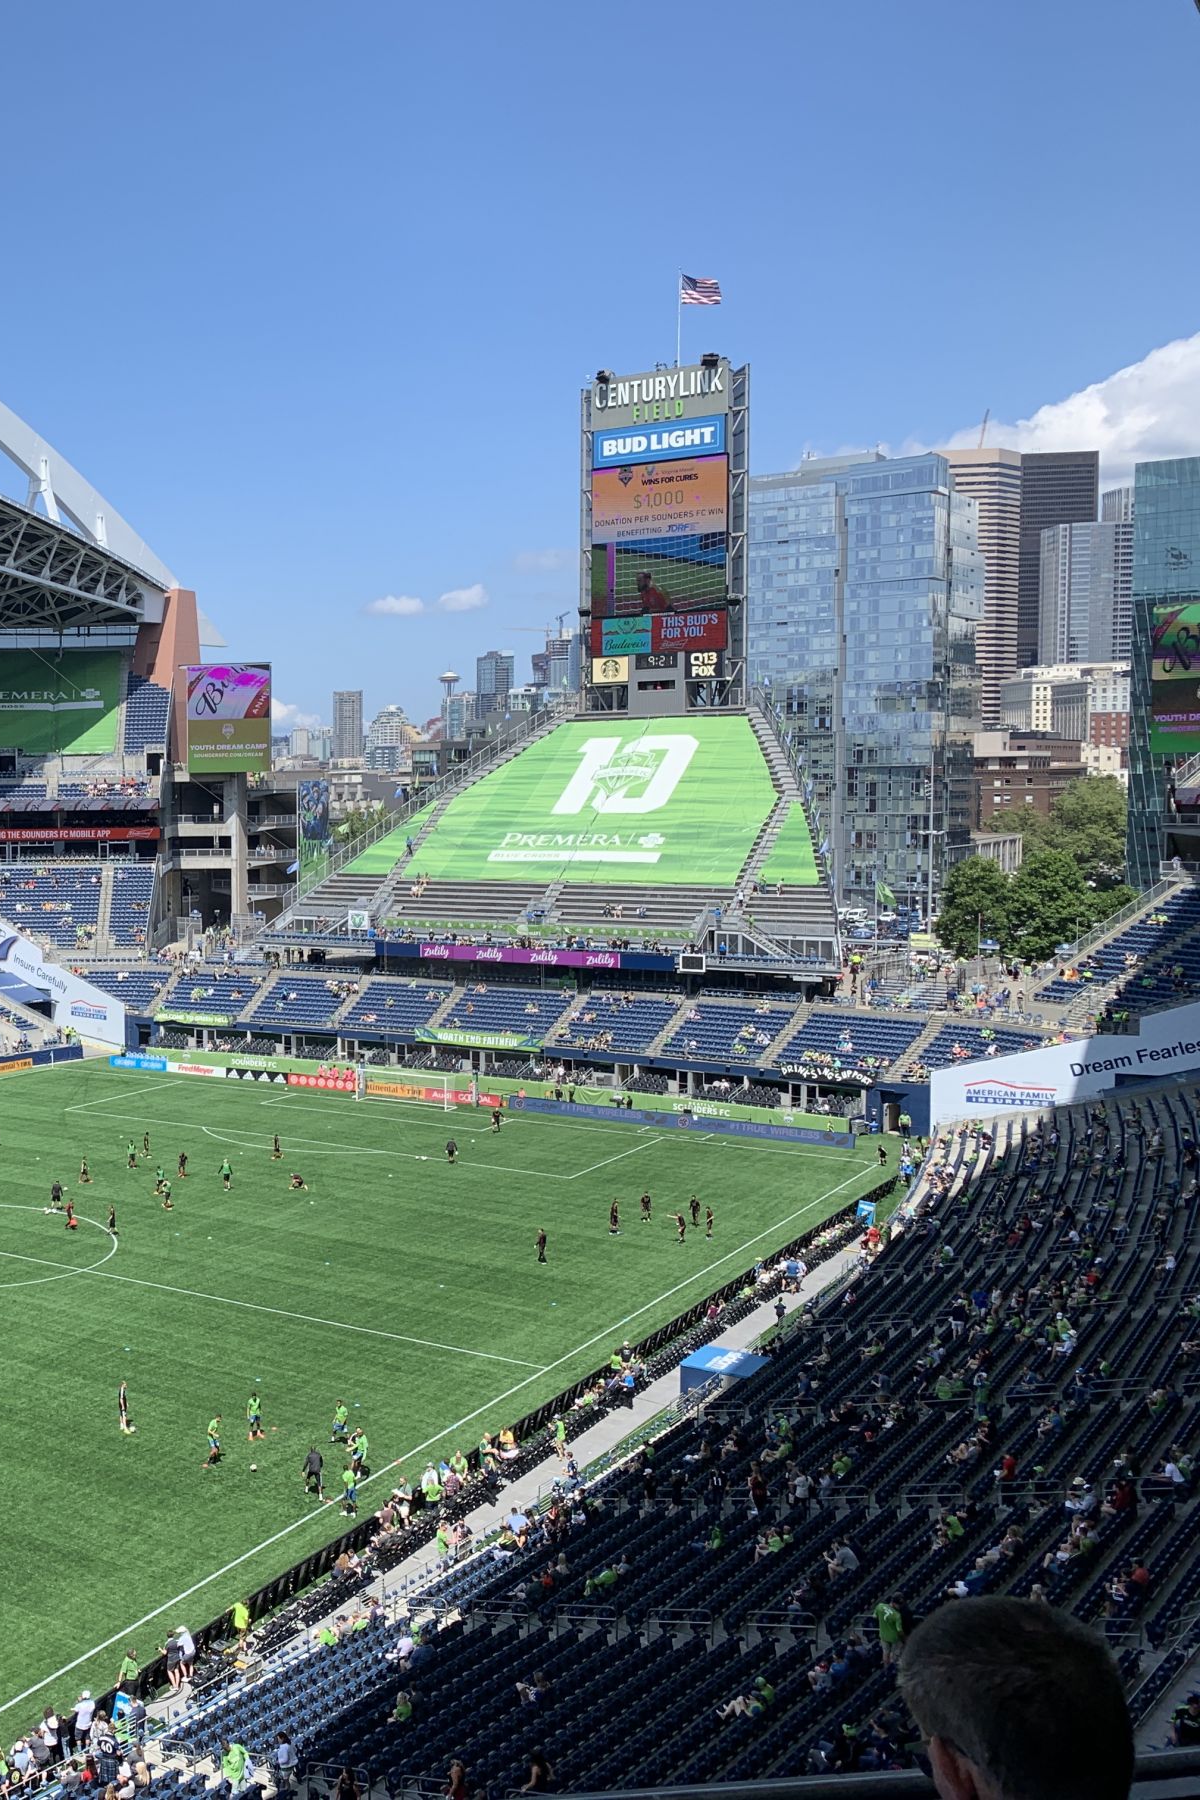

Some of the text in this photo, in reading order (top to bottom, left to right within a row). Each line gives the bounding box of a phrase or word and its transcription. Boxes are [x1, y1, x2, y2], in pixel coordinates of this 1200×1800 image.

[595, 367, 724, 409] CENTURYLINK
[633, 399, 684, 423] FIELD
[603, 426, 715, 457] BUD LIGHT
[641, 473, 699, 486] WINS FOR CURES
[634, 490, 684, 509] $1,000
[594, 507, 724, 528] DONATION PER SOUNDERS FC WIN
[617, 523, 690, 538] BENEFITTING JDRF
[661, 613, 718, 628] THIS BUD'S
[661, 627, 706, 639] FOR YOU.
[690, 652, 717, 664] Q13
[691, 664, 715, 677] FOX
[1153, 714, 1187, 722] YOUTH
[550, 734, 700, 815] 10
[7, 831, 21, 839] THE
[69, 830, 96, 838] MOBILE
[500, 832, 622, 847] PREMERA
[13, 954, 68, 994] Insure Carefully
[438, 1033, 518, 1046] NORTH END FAITHFUL
[177, 1064, 215, 1074] FredMeyer
[231, 1058, 266, 1069] SOUNDERS
[1070, 1055, 1133, 1077] Dream
[431, 1091, 452, 1099] Audi
[966, 1088, 1056, 1100] AMERICAN FAMILY
[972, 1097, 1050, 1106] INSURANCE
[572, 1105, 595, 1114] TRUE
[597, 1108, 642, 1119] WIRELESS
[741, 1124, 768, 1134] TRUE
[770, 1128, 820, 1140] WIRELESS
[100, 1741, 113, 1753] 40
